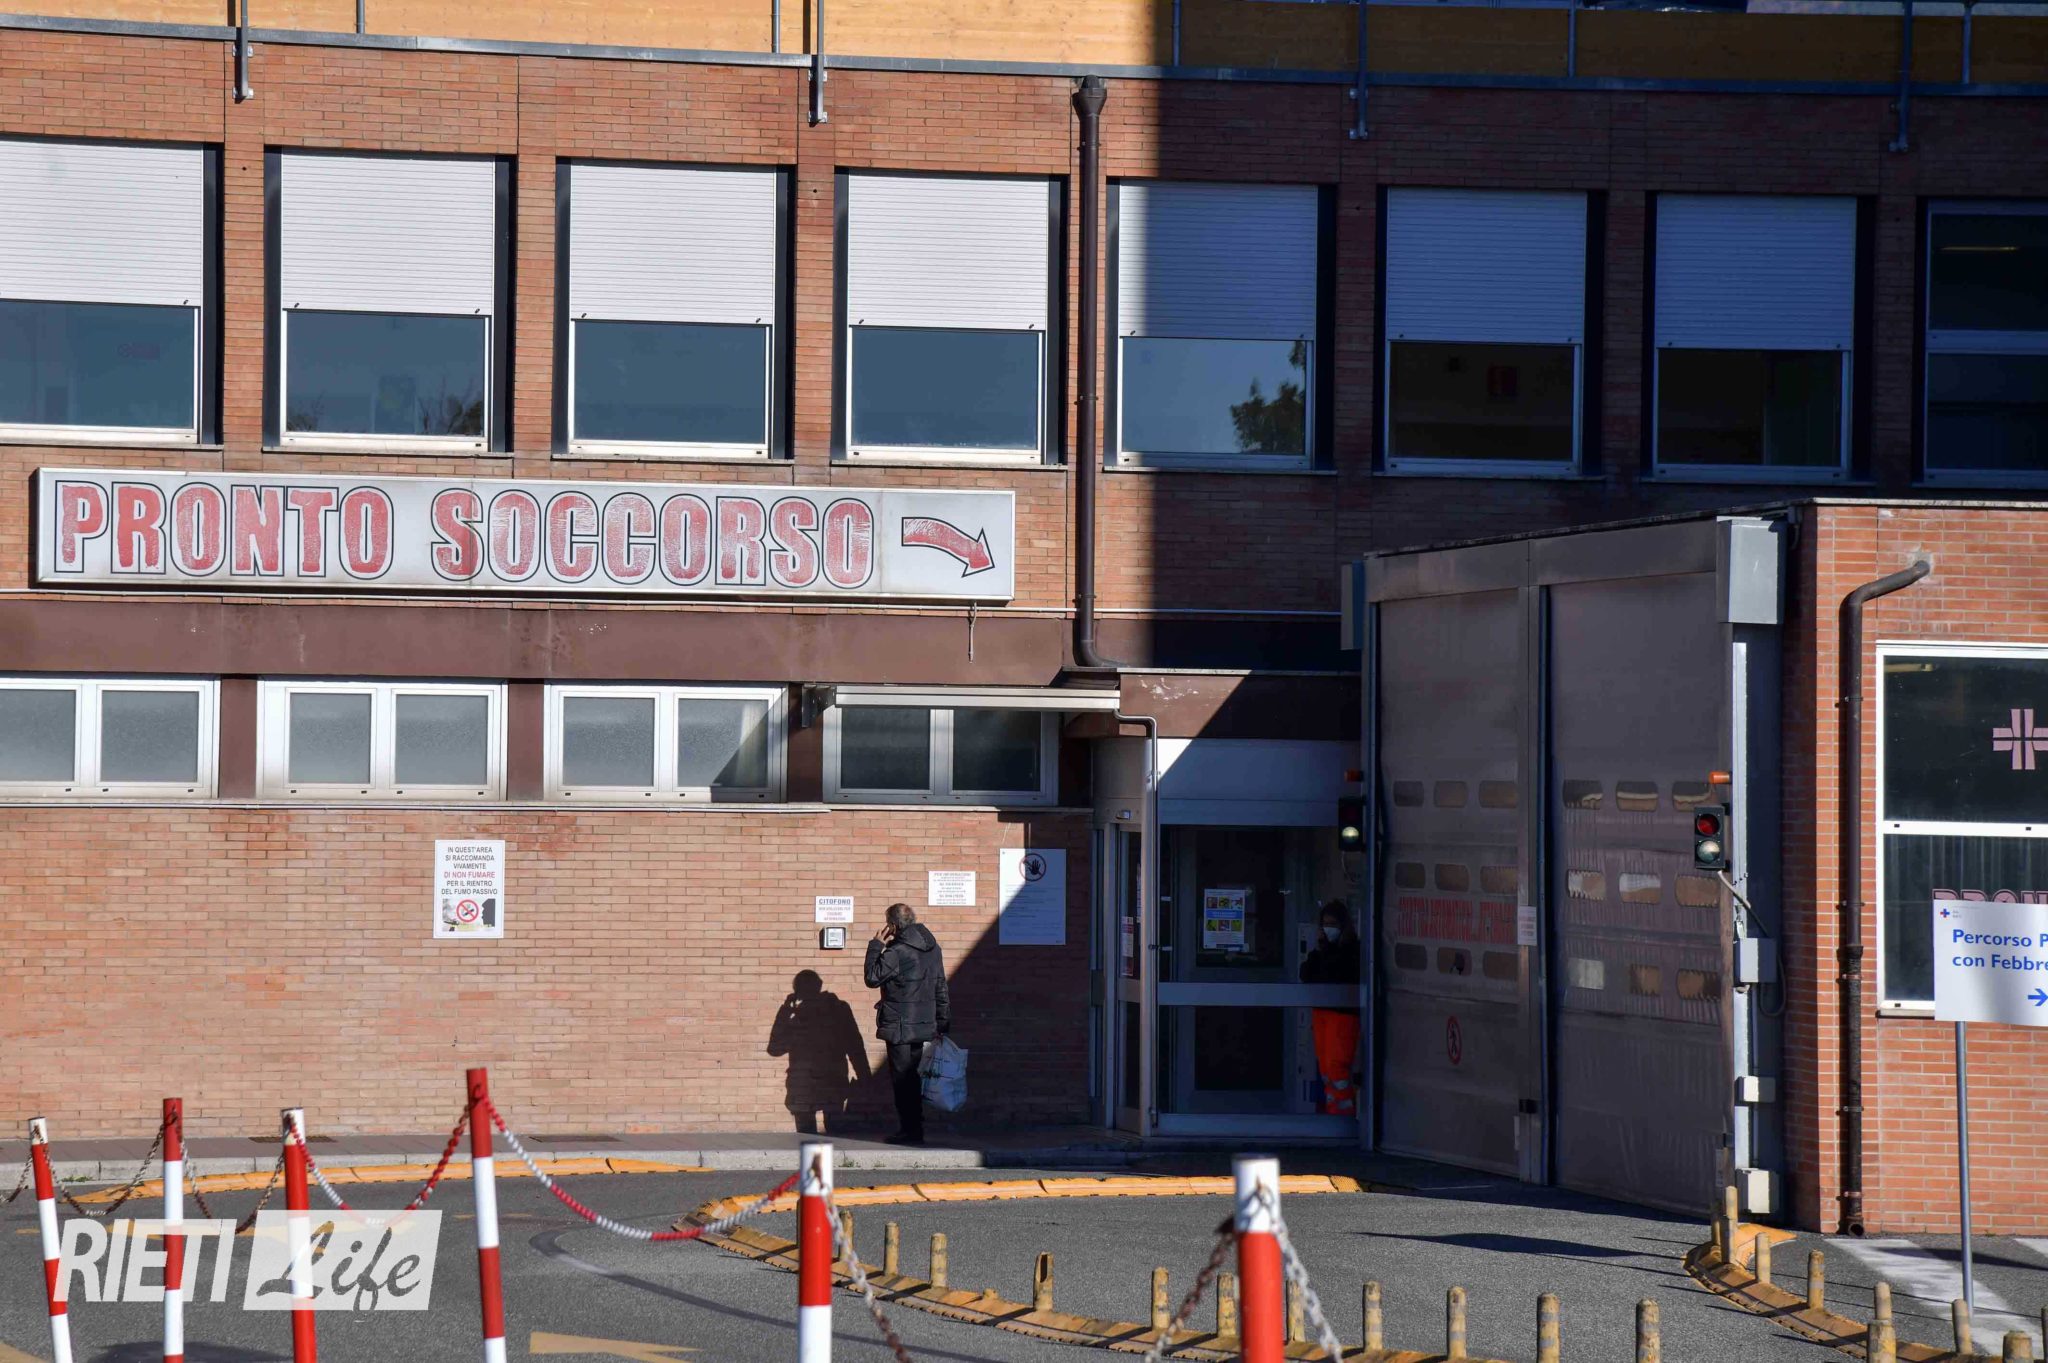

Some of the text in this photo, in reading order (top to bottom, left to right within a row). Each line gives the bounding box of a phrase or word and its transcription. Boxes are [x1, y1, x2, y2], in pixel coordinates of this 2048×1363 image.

[54, 480, 875, 589] PRONTO SOCCORSO
[1952, 929, 2032, 947] Percorso
[1952, 956, 1985, 968] con
